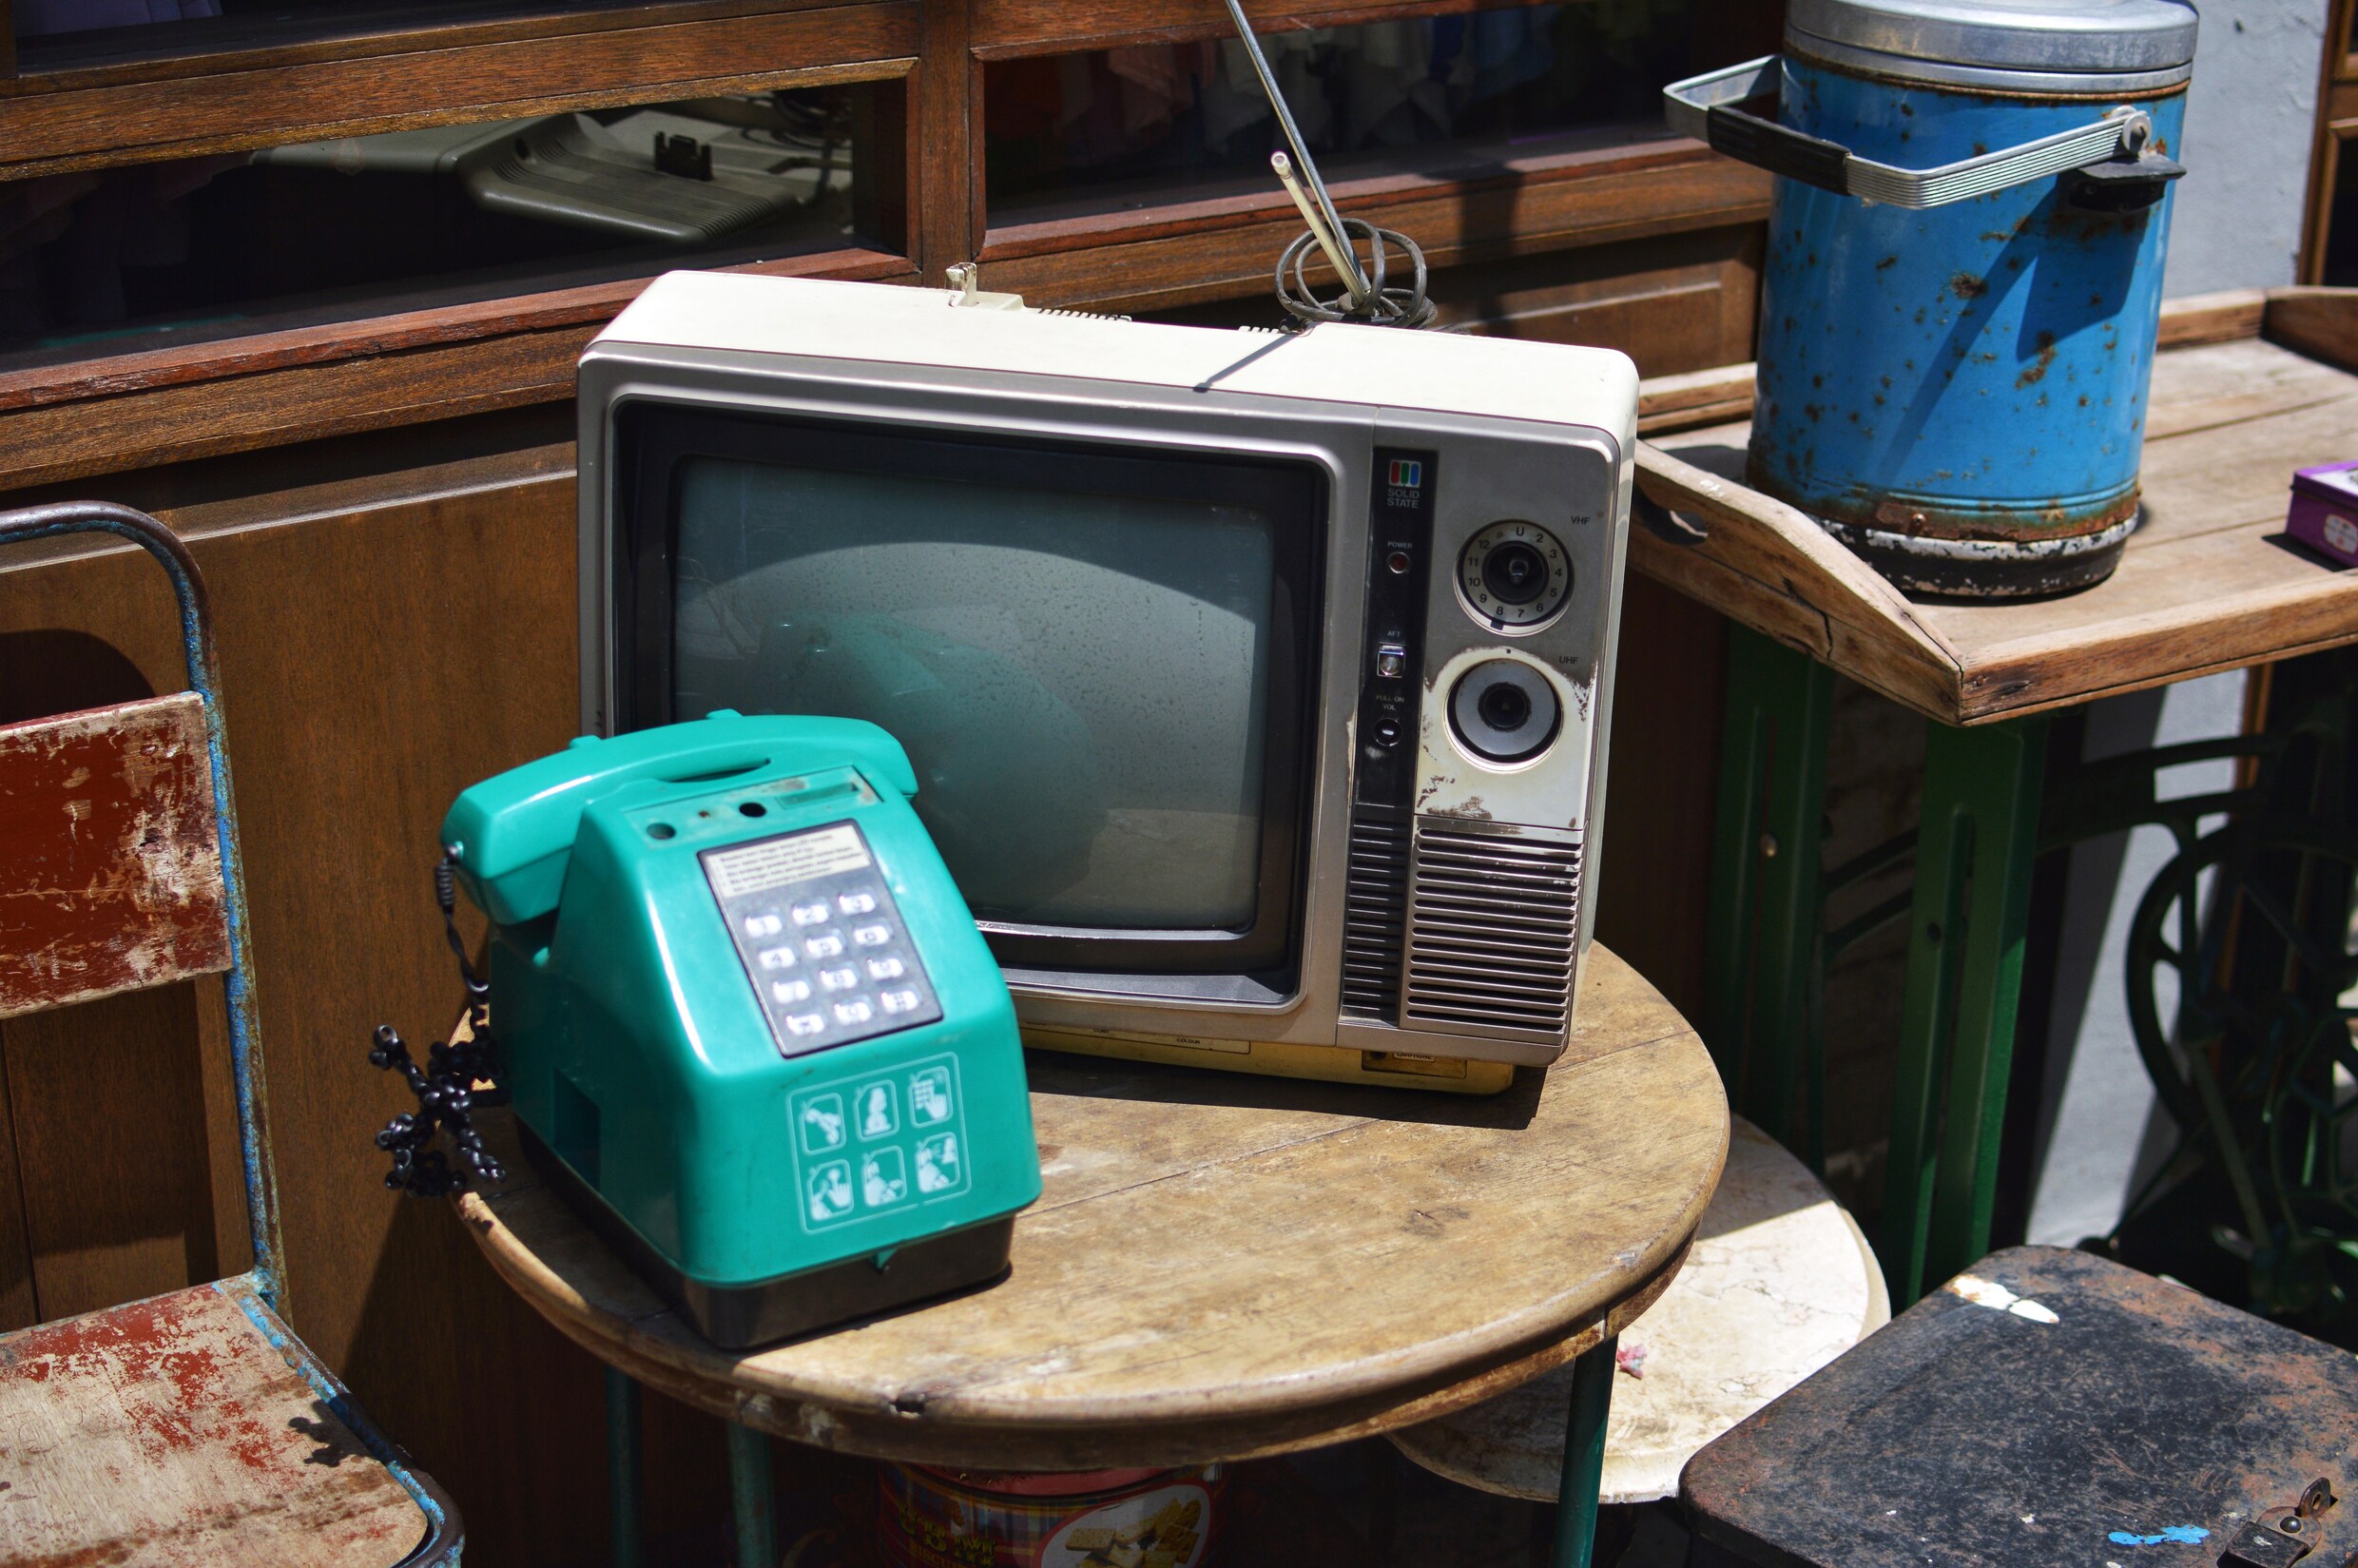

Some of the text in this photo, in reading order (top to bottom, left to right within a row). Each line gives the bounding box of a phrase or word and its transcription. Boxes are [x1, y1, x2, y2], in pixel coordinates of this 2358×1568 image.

[1387, 488, 1421, 499] SOLID
[1386, 497, 1420, 509] STATE
[1571, 516, 1590, 525] VHF
[1516, 527, 1524, 536] U
[1536, 533, 1544, 543] 2
[1387, 540, 1413, 549] POWER
[1478, 540, 1490, 550] 12
[1549, 549, 1557, 559] 3
[1468, 557, 1479, 566] 11
[1554, 568, 1563, 577] 4
[1468, 577, 1480, 587] 10
[1550, 588, 1557, 597] 5
[1479, 593, 1487, 603] 9
[1496, 606, 1504, 615] 8
[1536, 603, 1544, 612] 6
[1517, 609, 1525, 618] 7
[1559, 655, 1579, 665] UHF
[1382, 703, 1396, 711] VOL
